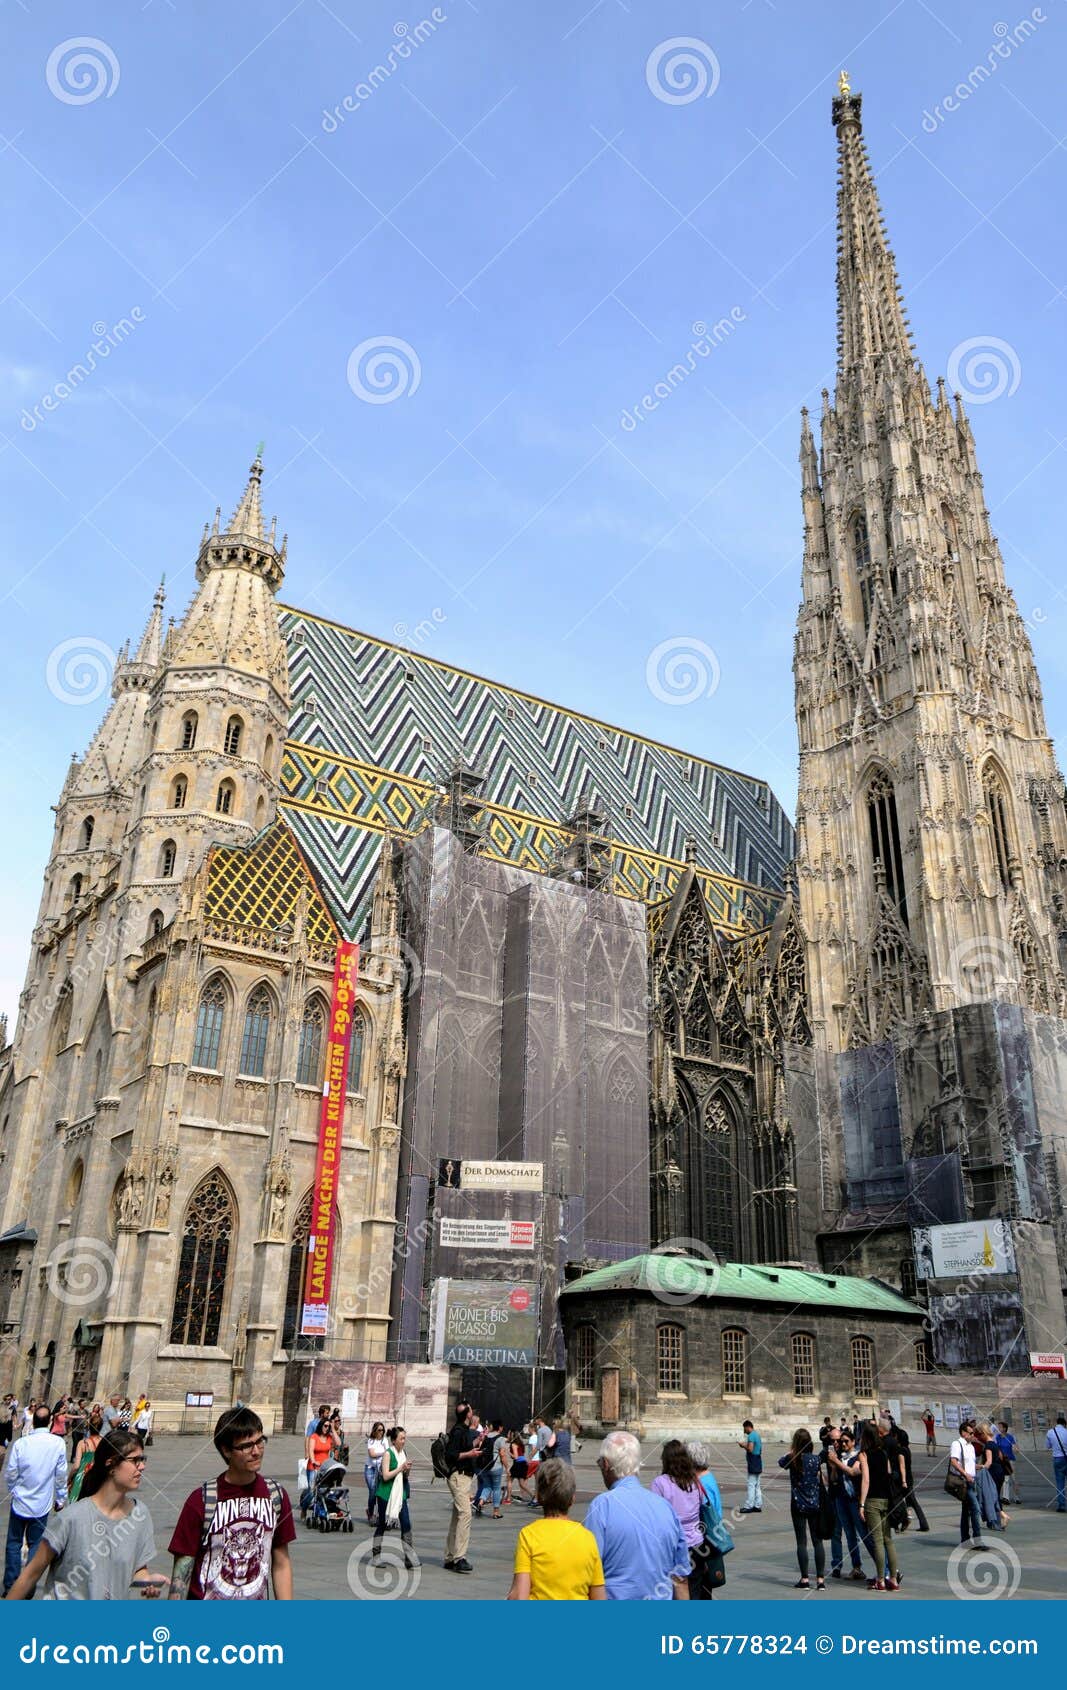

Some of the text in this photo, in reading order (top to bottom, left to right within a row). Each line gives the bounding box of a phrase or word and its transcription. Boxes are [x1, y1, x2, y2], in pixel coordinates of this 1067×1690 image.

[333, 954, 356, 1035] 29.05.15
[326, 1044, 345, 1121] KIRCHEN
[323, 1127, 337, 1162] DER
[464, 1166, 540, 1177] DER DOMSCHATZ
[316, 1169, 334, 1231] NACHT
[310, 1235, 329, 1299] LANGE
[447, 1320, 497, 1335] PICASSO
[448, 1307, 509, 1323] MONET BIS
[447, 1348, 528, 1363] ALBERTINA
